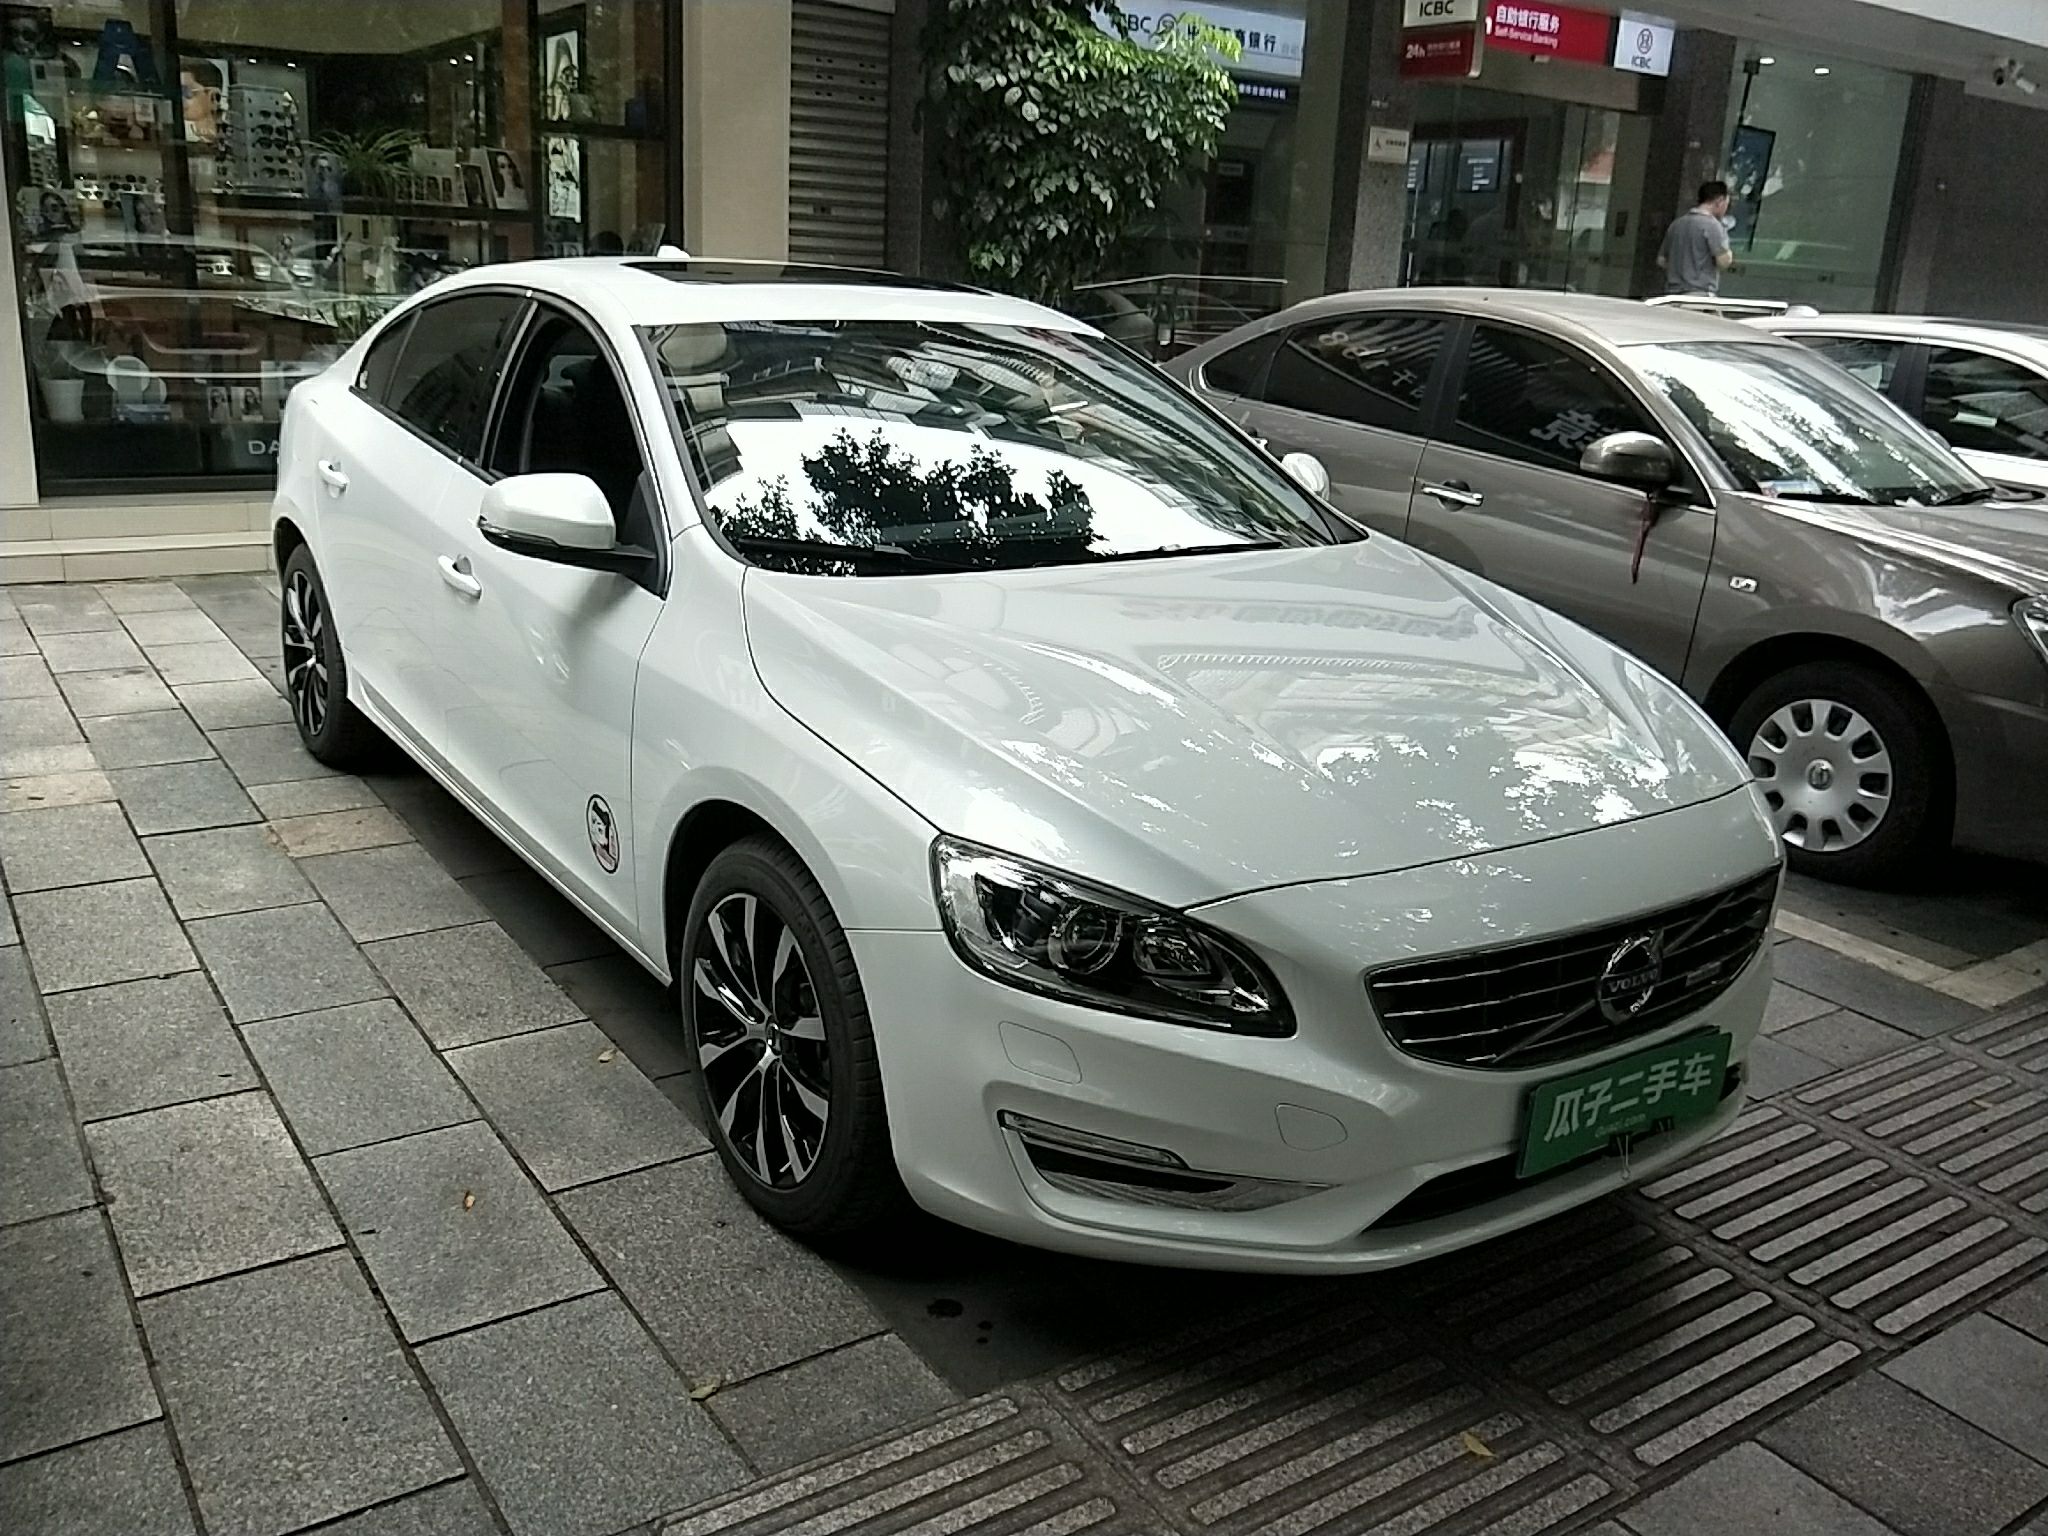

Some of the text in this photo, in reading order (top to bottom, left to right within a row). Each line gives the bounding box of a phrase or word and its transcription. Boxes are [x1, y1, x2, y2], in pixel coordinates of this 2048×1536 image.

[1419, 1, 1454, 17] ICBC
[1631, 55, 1652, 69] ICBC
[1608, 968, 1659, 993] VOLVO
[1543, 1052, 1716, 1143] 瓜子二手车
